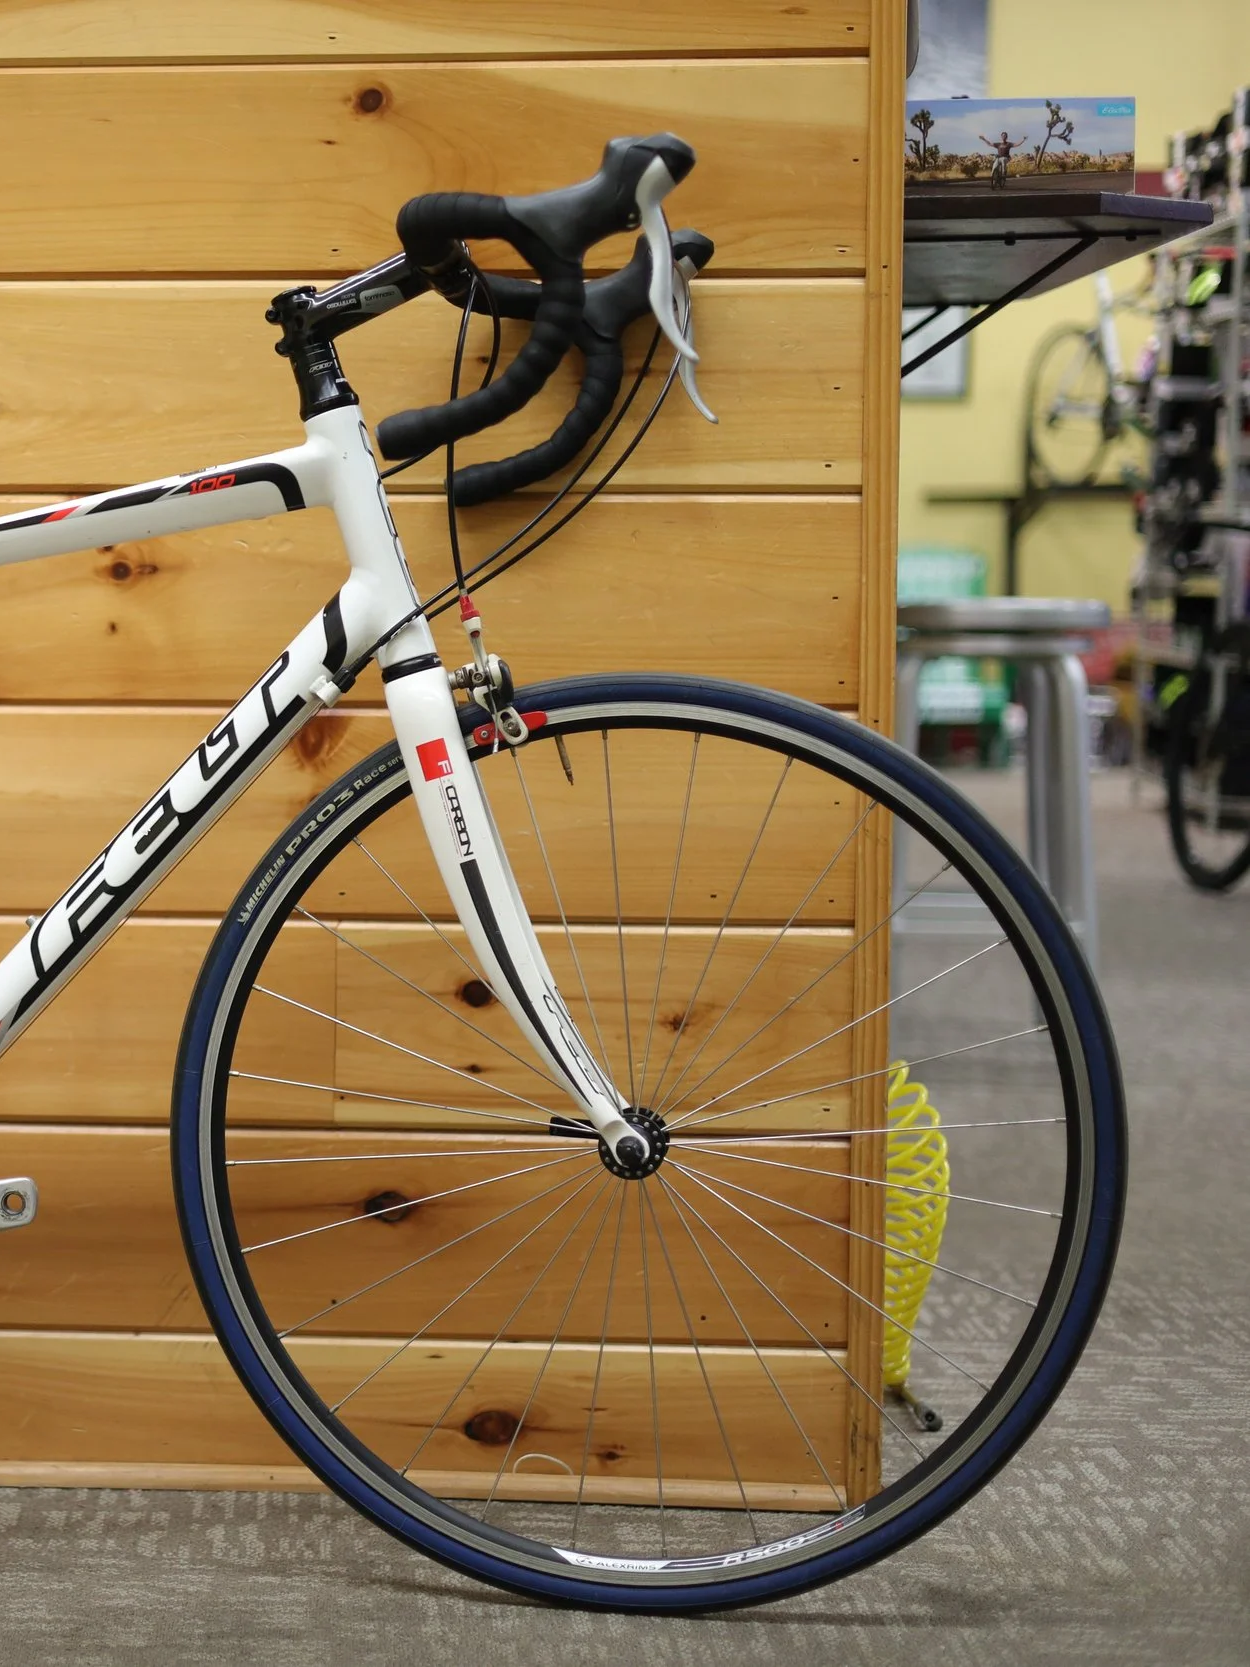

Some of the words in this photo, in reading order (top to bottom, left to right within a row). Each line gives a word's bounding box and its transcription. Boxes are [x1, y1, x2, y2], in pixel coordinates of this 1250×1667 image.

[189, 473, 236, 496] 100
[31, 650, 290, 979] FELT
[245, 854, 287, 912] MICHELIN
[285, 788, 355, 857] PRO3
[353, 763, 388, 791] Race
[445, 785, 474, 857] CARBON
[596, 1561, 658, 1571] ALEXRIMS
